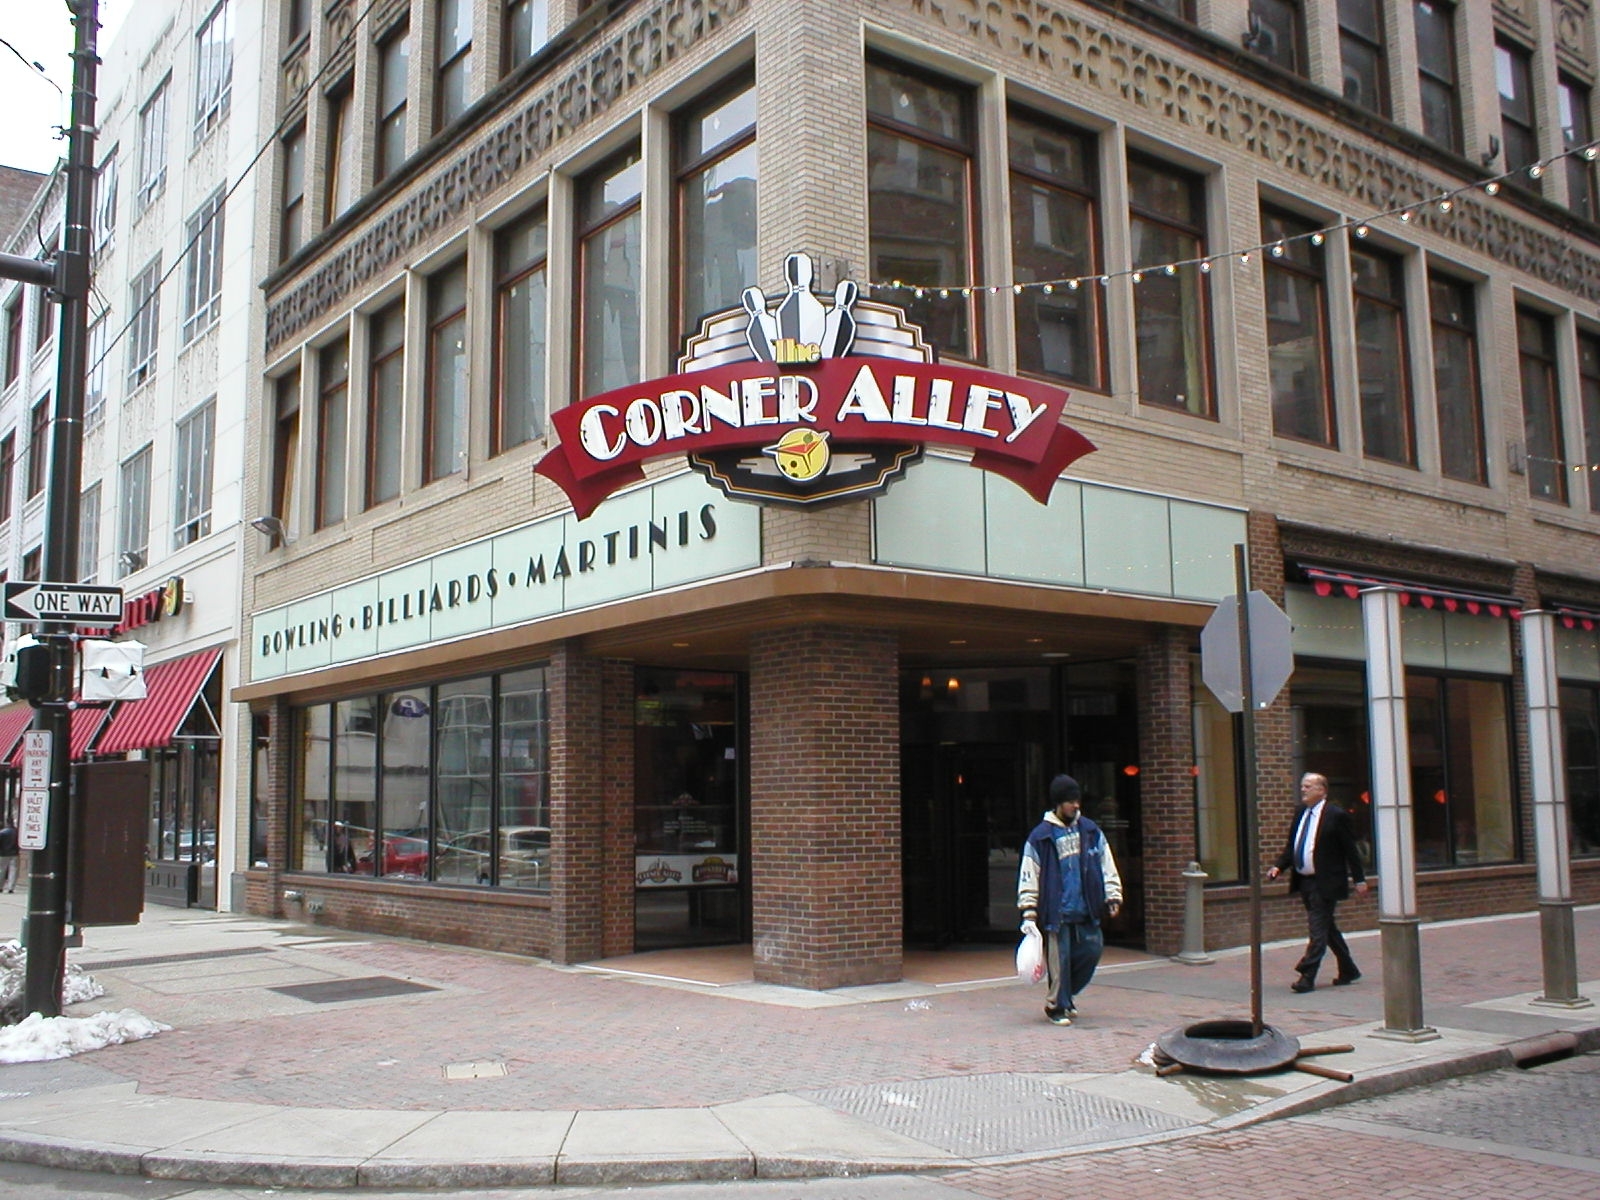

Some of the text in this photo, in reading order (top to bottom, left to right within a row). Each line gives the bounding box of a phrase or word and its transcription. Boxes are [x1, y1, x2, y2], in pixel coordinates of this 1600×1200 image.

[770, 337, 822, 364] The
[579, 363, 1049, 461] CORNER ALLEY
[261, 502, 718, 657] BOWLING BILLIARDS MARTINIS
[33, 592, 114, 613] ONE WAY
[32, 738, 43, 748] NO
[28, 814, 39, 822] ALL
